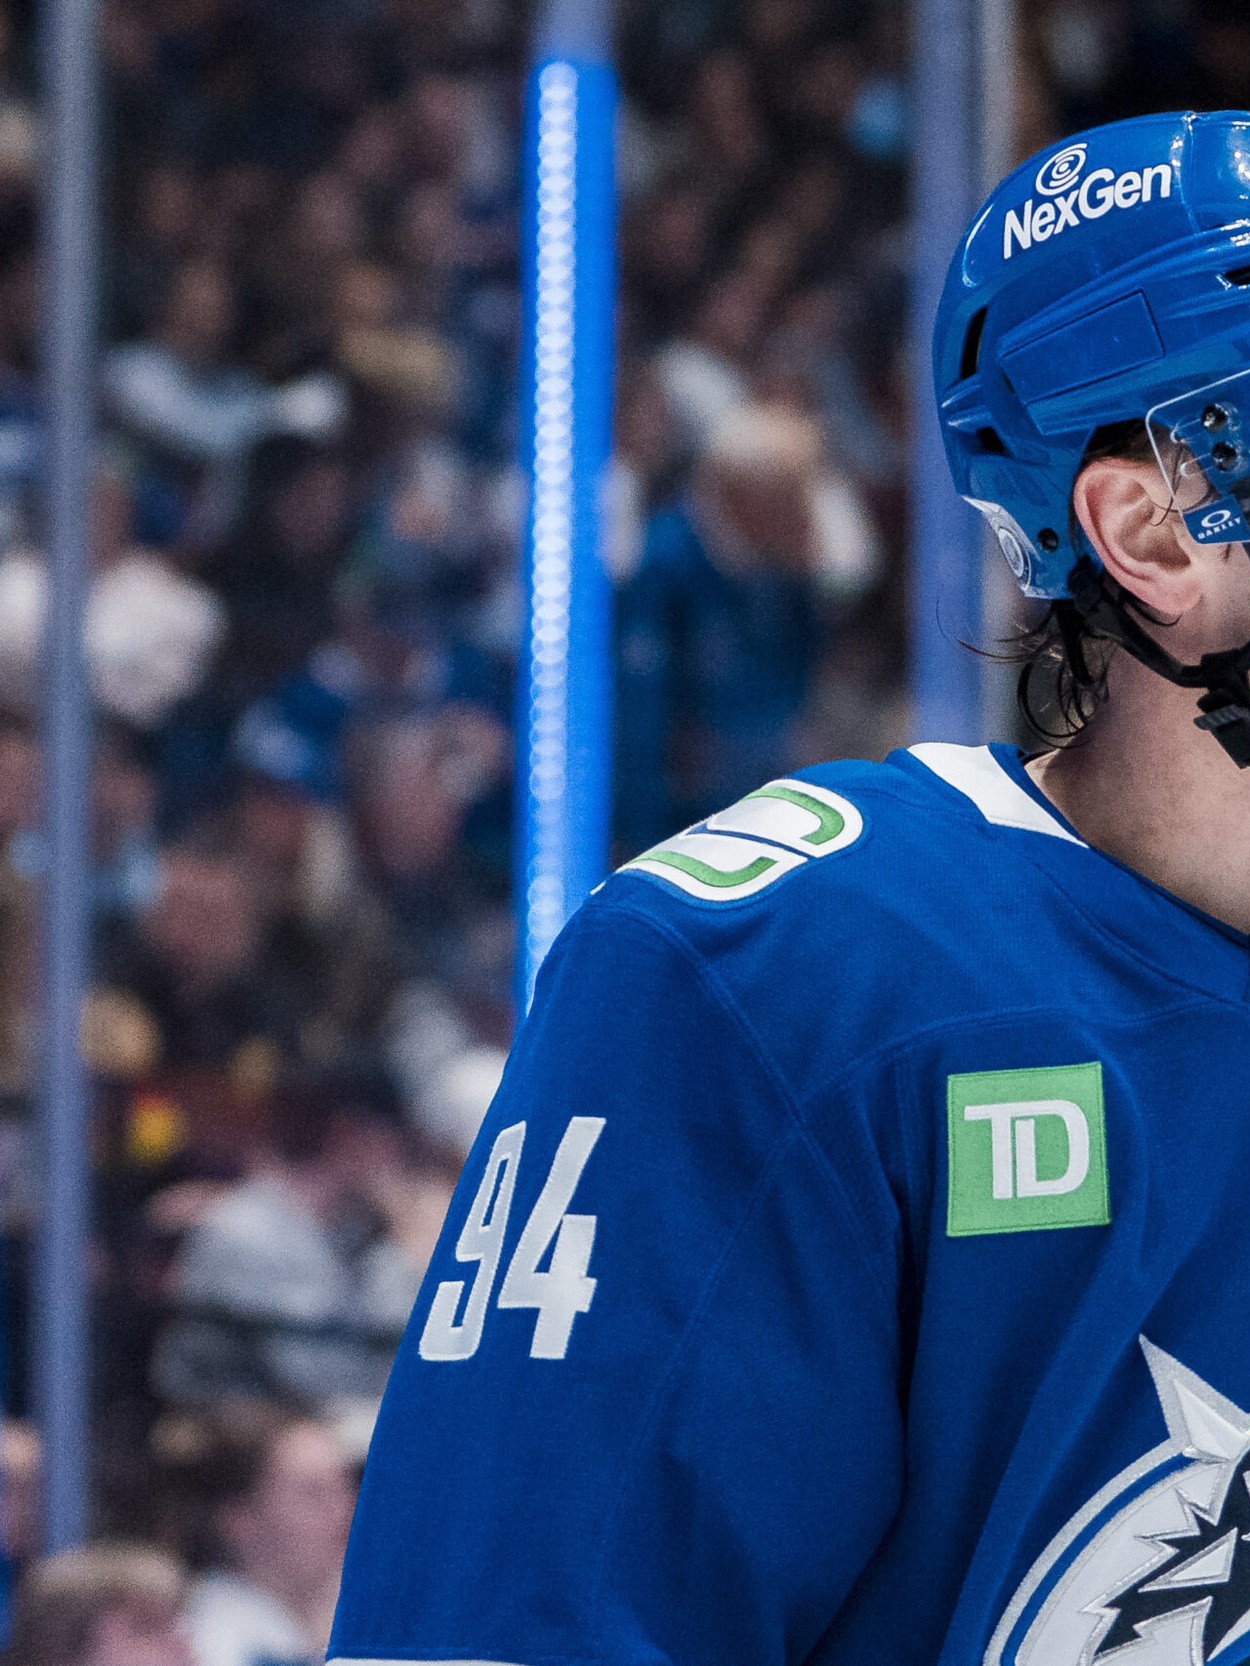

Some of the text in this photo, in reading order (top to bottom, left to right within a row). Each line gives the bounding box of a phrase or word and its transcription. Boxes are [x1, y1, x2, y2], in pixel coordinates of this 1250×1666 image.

[1003, 164, 1172, 259] NexGen
[964, 1099, 1090, 1199] TD
[418, 1116, 606, 1361] 94
